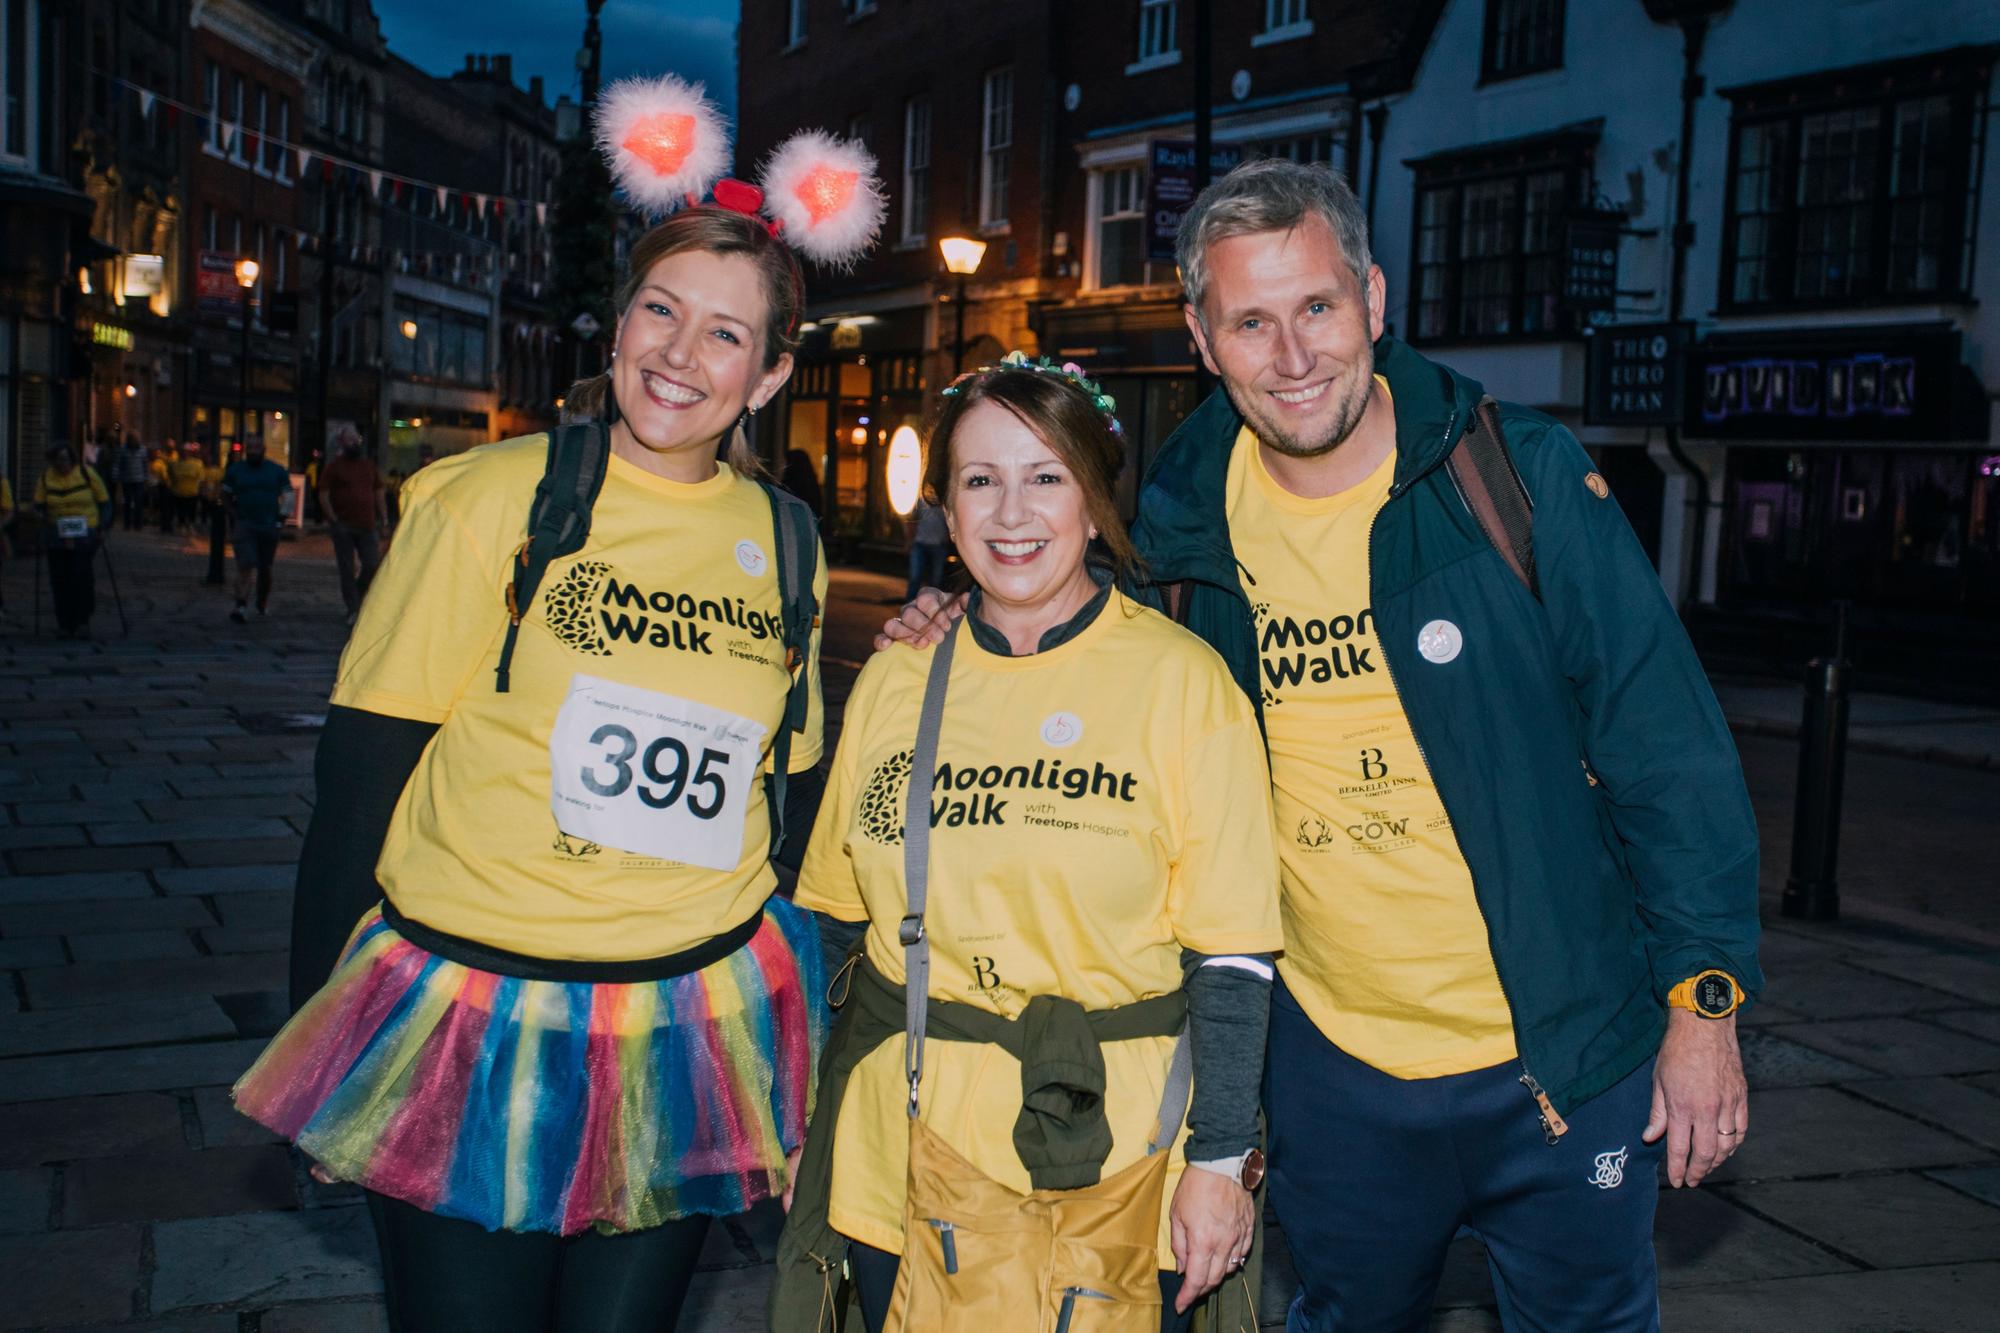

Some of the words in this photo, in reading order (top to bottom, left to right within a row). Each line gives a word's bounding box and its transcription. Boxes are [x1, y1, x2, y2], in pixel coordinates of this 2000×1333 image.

[1612, 338, 1649, 359] THE
[1611, 364, 1665, 385] EURO
[1611, 390, 1663, 411] PEAN
[601, 578, 784, 641] Moonligh
[601, 610, 713, 655] Walk
[1261, 608, 1374, 652] Moon
[726, 639, 753, 650] with
[728, 649, 769, 665] Treetops
[1262, 644, 1376, 689] Walk
[580, 723, 730, 820] 395
[1338, 780, 1390, 795] BERKELEY
[1392, 777, 1417, 786] INNS
[1025, 803, 1057, 814] with
[1362, 810, 1390, 821] THE
[1023, 815, 1079, 830] Treetops
[1082, 821, 1130, 837] Hospice
[1346, 817, 1409, 841] COW
